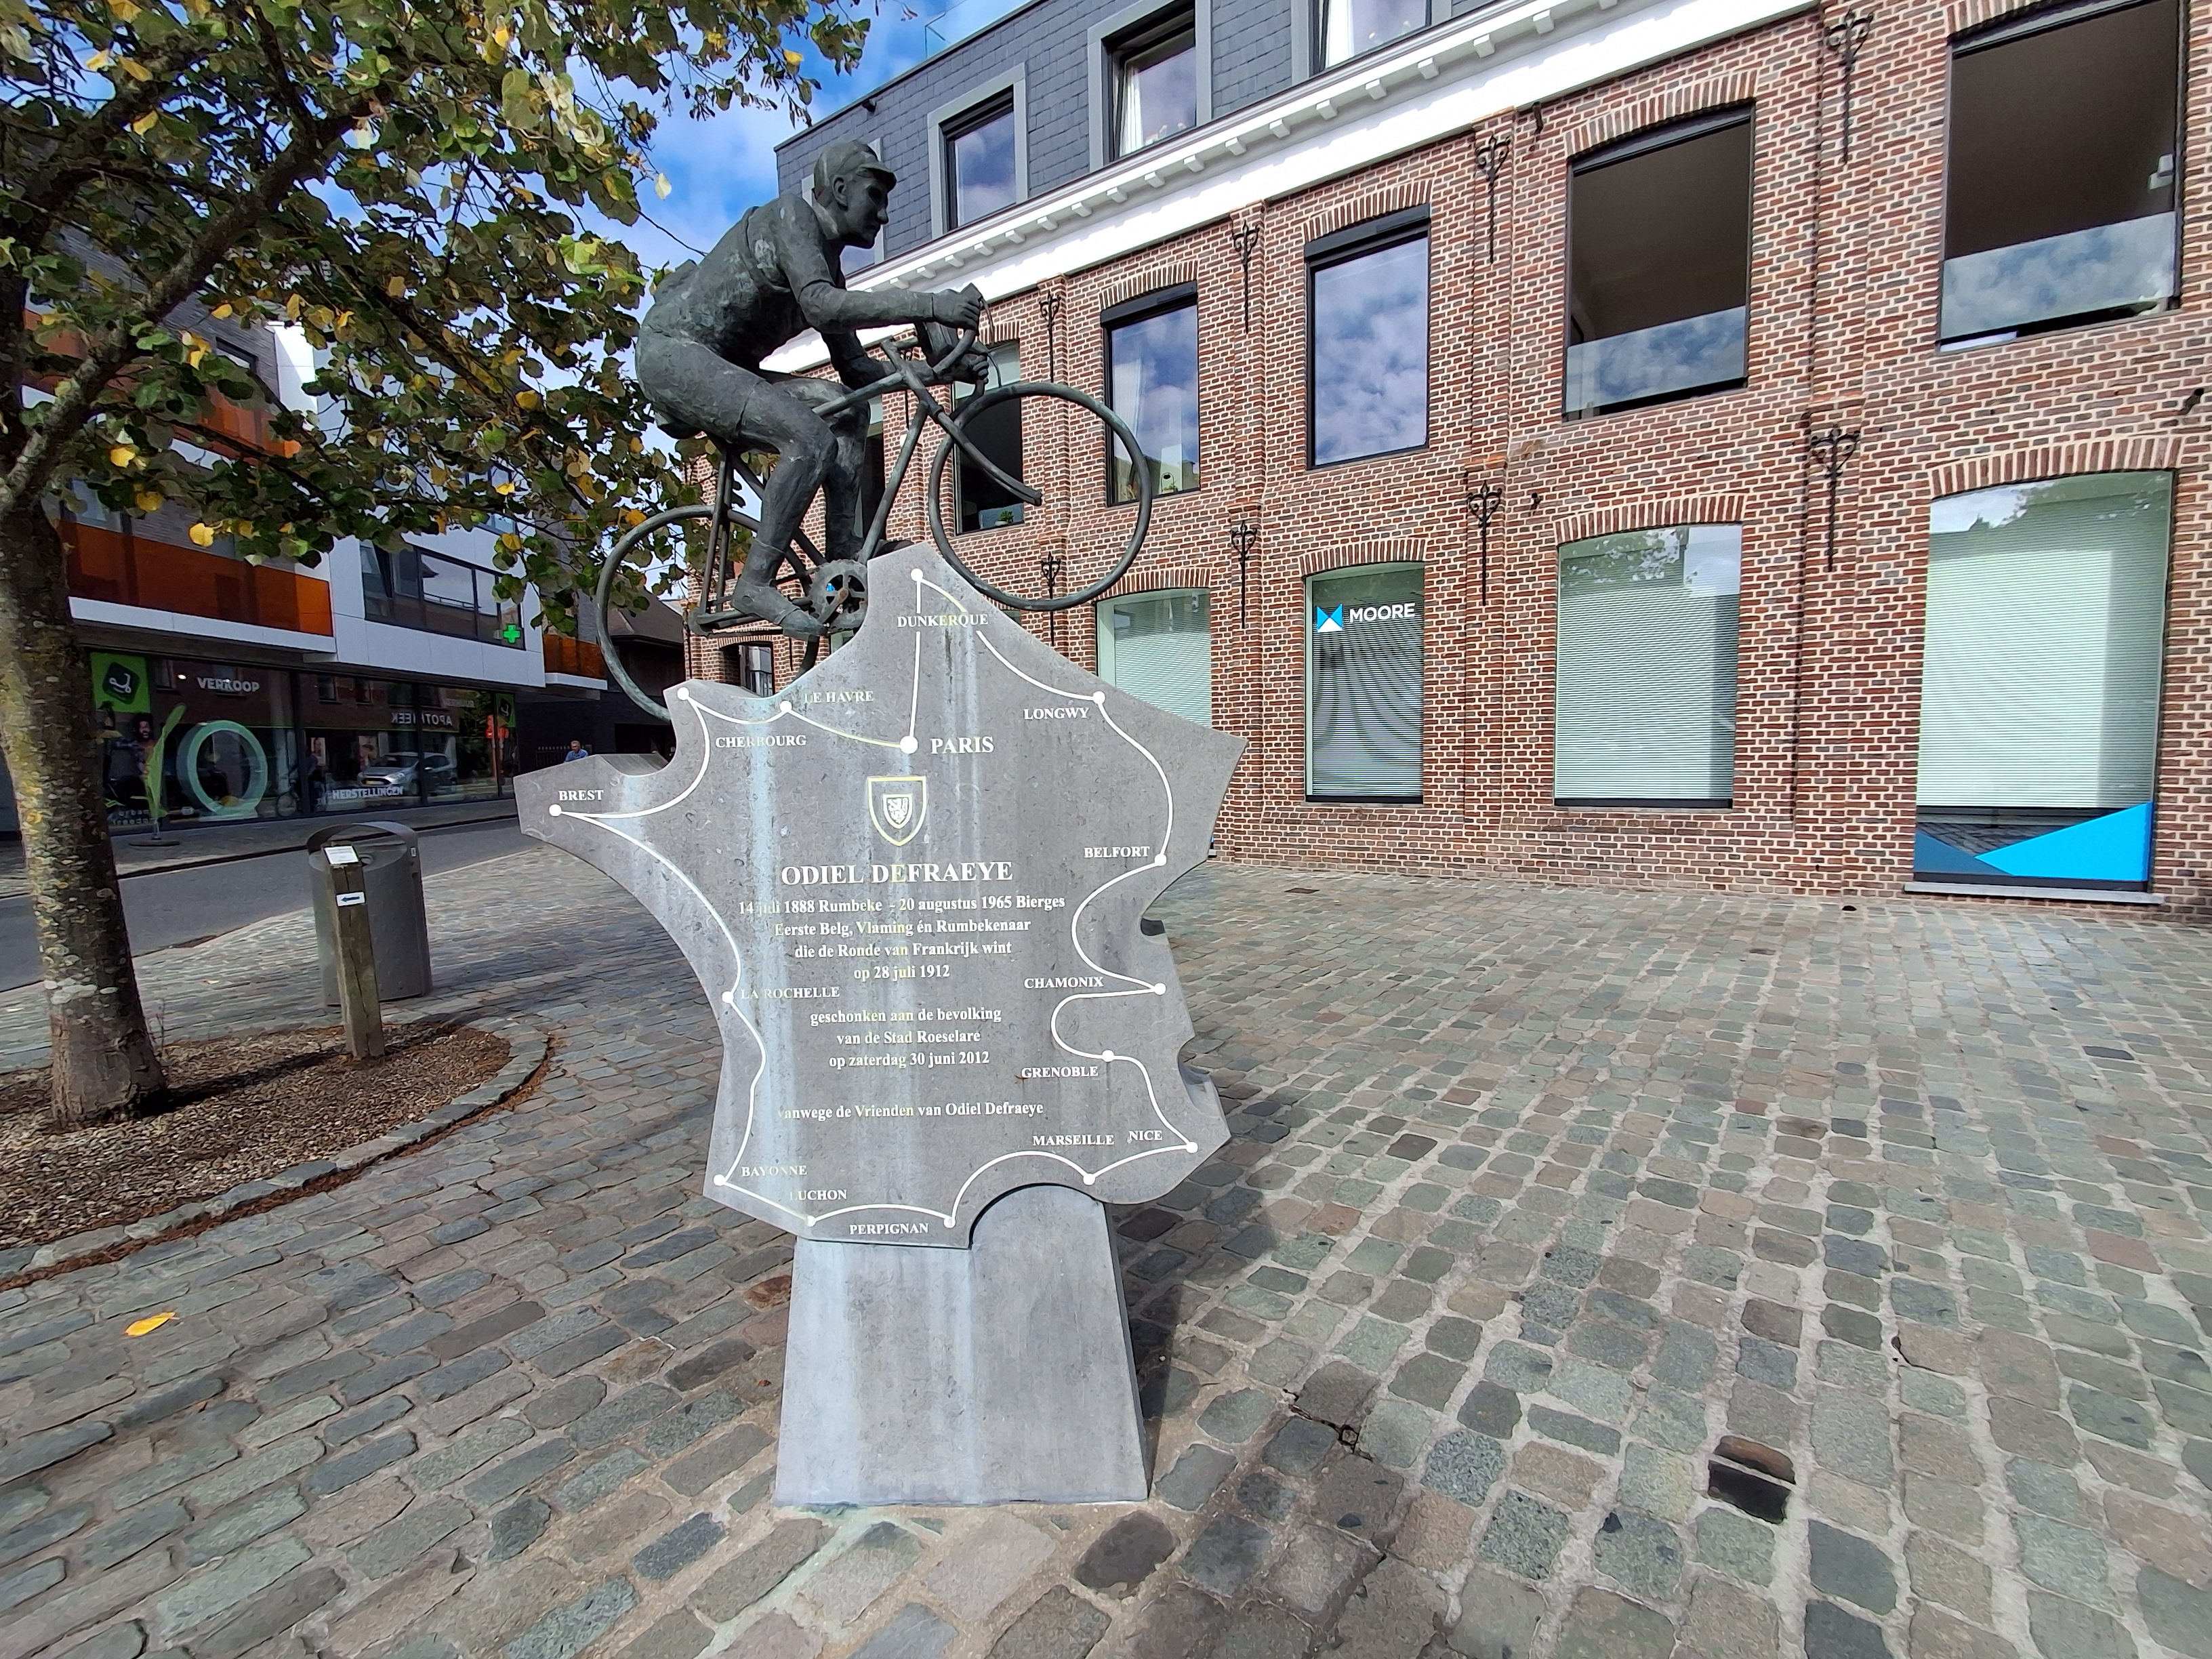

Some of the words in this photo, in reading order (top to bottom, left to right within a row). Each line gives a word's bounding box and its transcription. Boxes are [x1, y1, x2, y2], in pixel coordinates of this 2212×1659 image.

[1349, 602, 1416, 623] MOORE
[897, 614, 989, 628] DUNKERQUE
[197, 676, 260, 693] VERKOOP
[825, 691, 874, 703] HAVRE
[1023, 707, 1089, 720] LONGWY
[715, 735, 807, 747] CHERBOURG
[930, 736, 994, 754] PARIS
[332, 785, 404, 800] HERSTELLINGEN
[558, 790, 604, 801] BREST
[1084, 846, 1150, 858] BELFORT
[781, 864, 864, 885] ODIEL
[870, 861, 1013, 883] DEFRAEYE
[739, 901, 754, 914] 14
[784, 899, 815, 914] 1888
[818, 899, 882, 913] Rumbeke
[898, 897, 915, 911] 20
[918, 898, 977, 914] augustus
[981, 895, 1012, 909] 1965
[1016, 895, 1065, 911] Bierges
[775, 922, 817, 936] Eerste
[819, 922, 853, 938] Belg,
[855, 920, 914, 937] Vlaming
[916, 920, 933, 933] én
[936, 918, 1031, 933] Rumbekenaar
[794, 945, 815, 958] die
[818, 944, 834, 958] de
[837, 943, 881, 957] Ronde
[884, 945, 908, 956] van
[912, 941, 979, 958] Frankrijk
[981, 940, 1012, 954] wint
[853, 969, 870, 982] op
[874, 966, 890, 979] 28
[892, 965, 916, 982] juli
[920, 964, 950, 978] 1912
[1024, 976, 1104, 989] CHAMONIX
[741, 989, 758, 999] LA
[764, 987, 840, 998] ROCHELLE
[810, 1009, 886, 1027] geschonken
[889, 1012, 914, 1022] aan
[918, 1008, 934, 1021] de
[937, 1006, 1002, 1023] bevolking
[836, 1035, 861, 1044] van
[865, 1031, 880, 1044] de
[884, 1030, 913, 1044] Stad
[917, 1029, 981, 1043] Roeselare
[829, 1057, 846, 1070] op
[848, 1053, 907, 1069] zaterdag
[909, 1052, 925, 1065] 30
[928, 1051, 956, 1068] juni
[959, 1050, 989, 1064] 2012
[1021, 1066, 1099, 1078] GRENOBLE
[779, 1108, 832, 1121] vanwege
[836, 1105, 852, 1118] de
[854, 1104, 914, 1117] Vrienden
[918, 1106, 942, 1116] van
[945, 1102, 981, 1115] Odiel
[985, 1101, 1044, 1118] Defraeye
[1033, 1134, 1115, 1146] MARSEILLE
[1127, 1130, 1163, 1143] NICE
[741, 1166, 808, 1176] BAYONNE
[849, 1223, 929, 1235] PERPIGNAN
